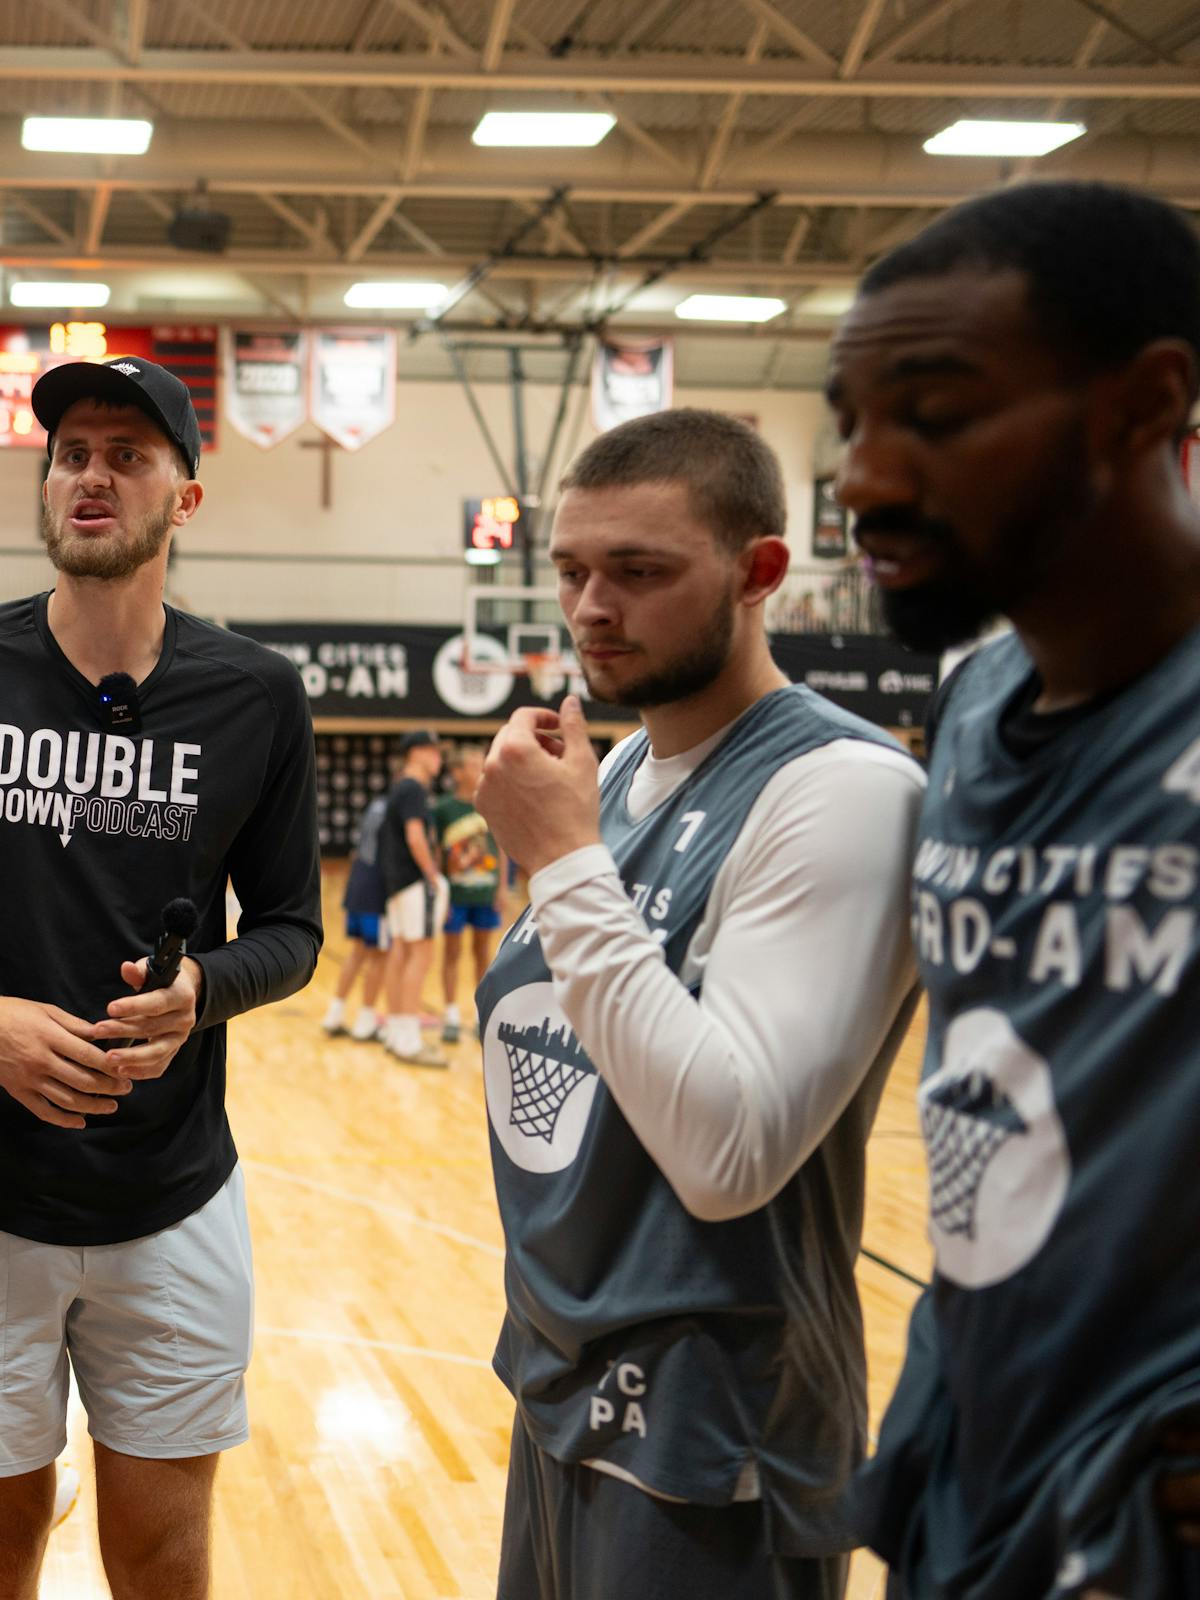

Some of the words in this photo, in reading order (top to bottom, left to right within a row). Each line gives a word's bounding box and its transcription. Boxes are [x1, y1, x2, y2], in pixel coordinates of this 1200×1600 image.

[302, 663, 408, 698] O-AM
[673, 810, 707, 853] 1
[981, 842, 1200, 899] CITIES
[910, 889, 1195, 997] RO-AM
[589, 1395, 648, 1439] PA
